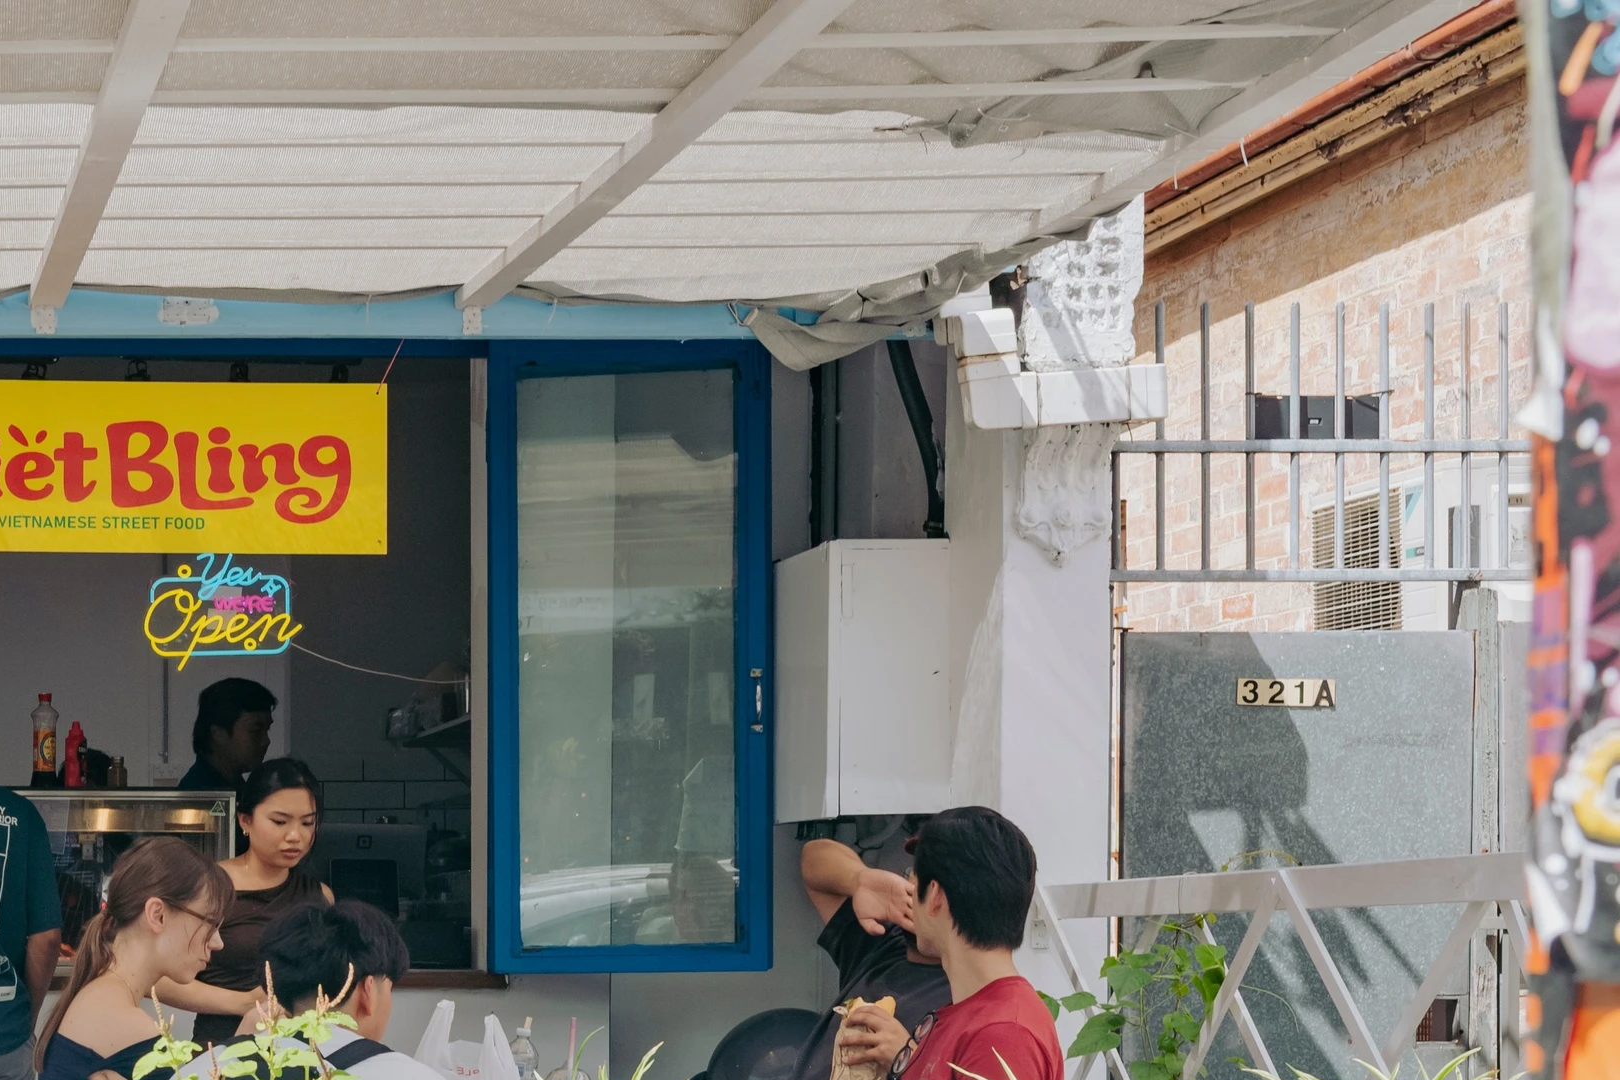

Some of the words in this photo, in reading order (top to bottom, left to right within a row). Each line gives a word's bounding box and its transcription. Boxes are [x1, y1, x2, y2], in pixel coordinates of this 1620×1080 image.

[101, 515, 161, 530] STREET
[164, 516, 205, 530] FOOD
[196, 552, 262, 601] Yes
[144, 588, 303, 672] Open
[1241, 679, 1335, 707] 321A
